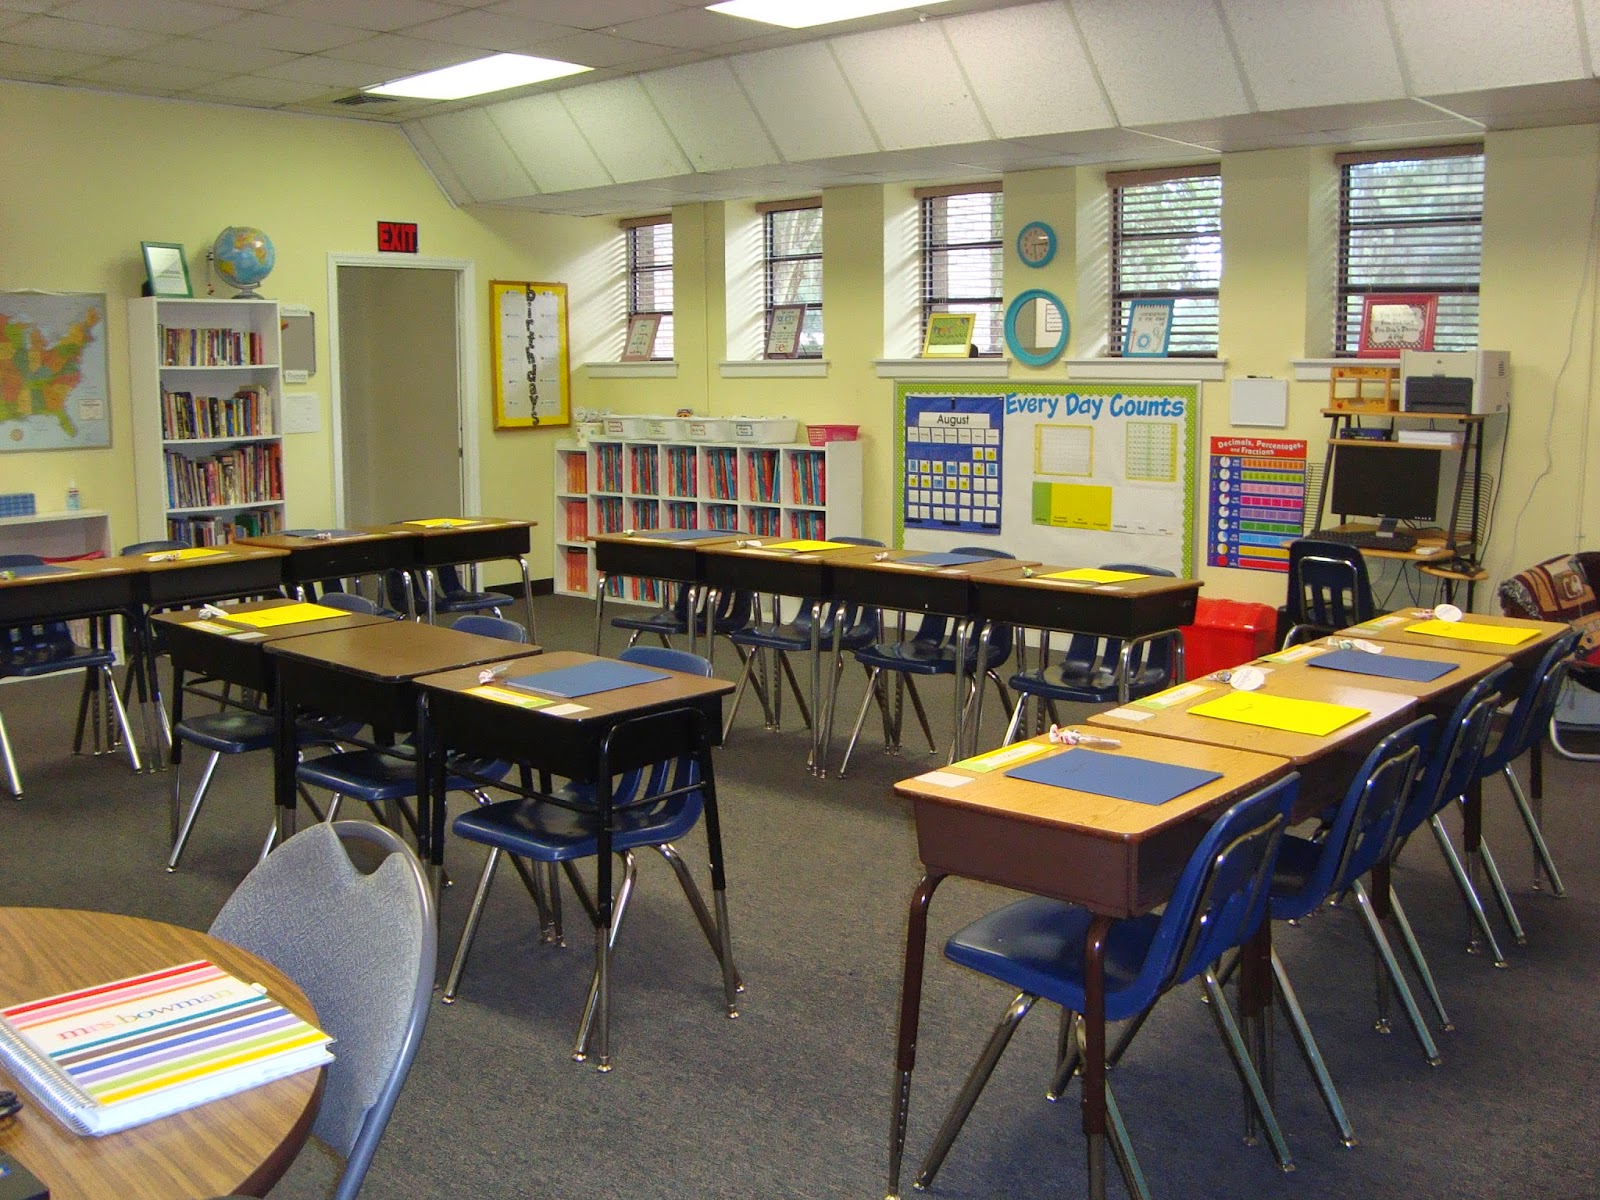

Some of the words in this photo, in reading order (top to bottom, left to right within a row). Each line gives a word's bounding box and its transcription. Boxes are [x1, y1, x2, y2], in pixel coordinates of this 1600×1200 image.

[379, 223, 416, 252] EXIT
[937, 414, 970, 426] August
[1005, 391, 1059, 419] Every
[1065, 392, 1103, 420] Day
[1109, 393, 1185, 417] Counts
[1240, 447, 1275, 455] Fractions
[57, 1019, 115, 1040] mrs
[117, 989, 233, 1024] bowman
